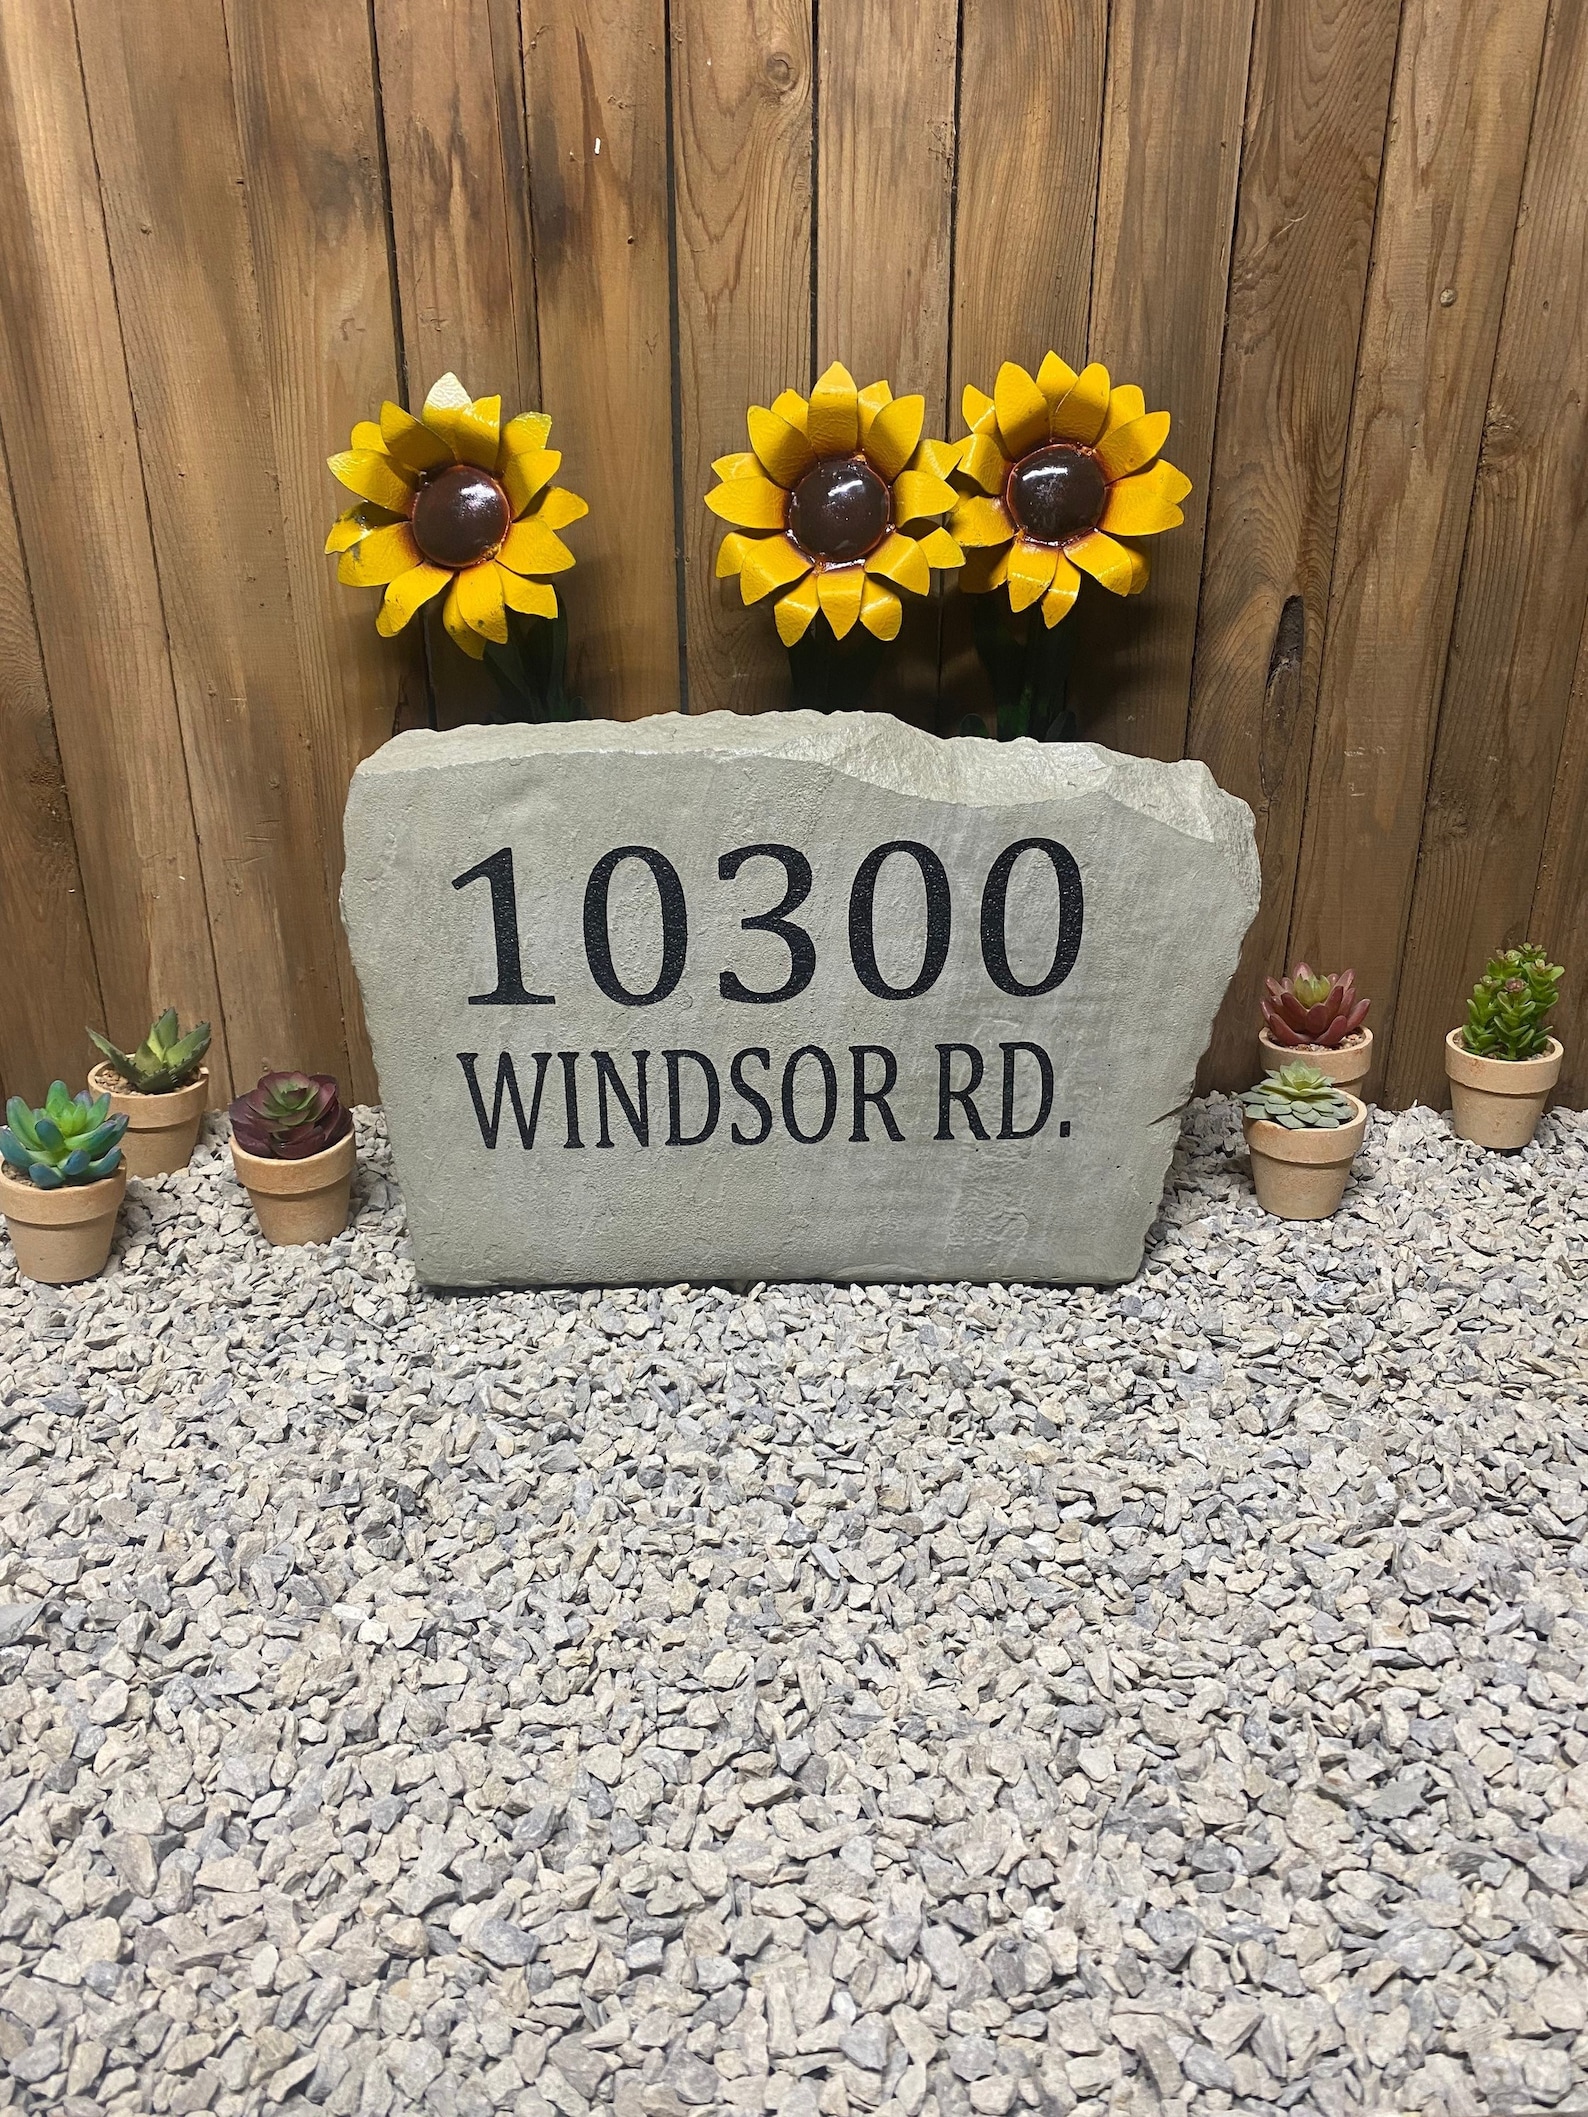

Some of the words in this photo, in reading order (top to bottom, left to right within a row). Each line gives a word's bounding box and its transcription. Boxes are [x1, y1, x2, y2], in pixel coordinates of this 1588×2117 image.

[450, 836, 1085, 1010] 10300
[455, 1041, 907, 1151] WINDSOR
[932, 1041, 1072, 1141] RD.
